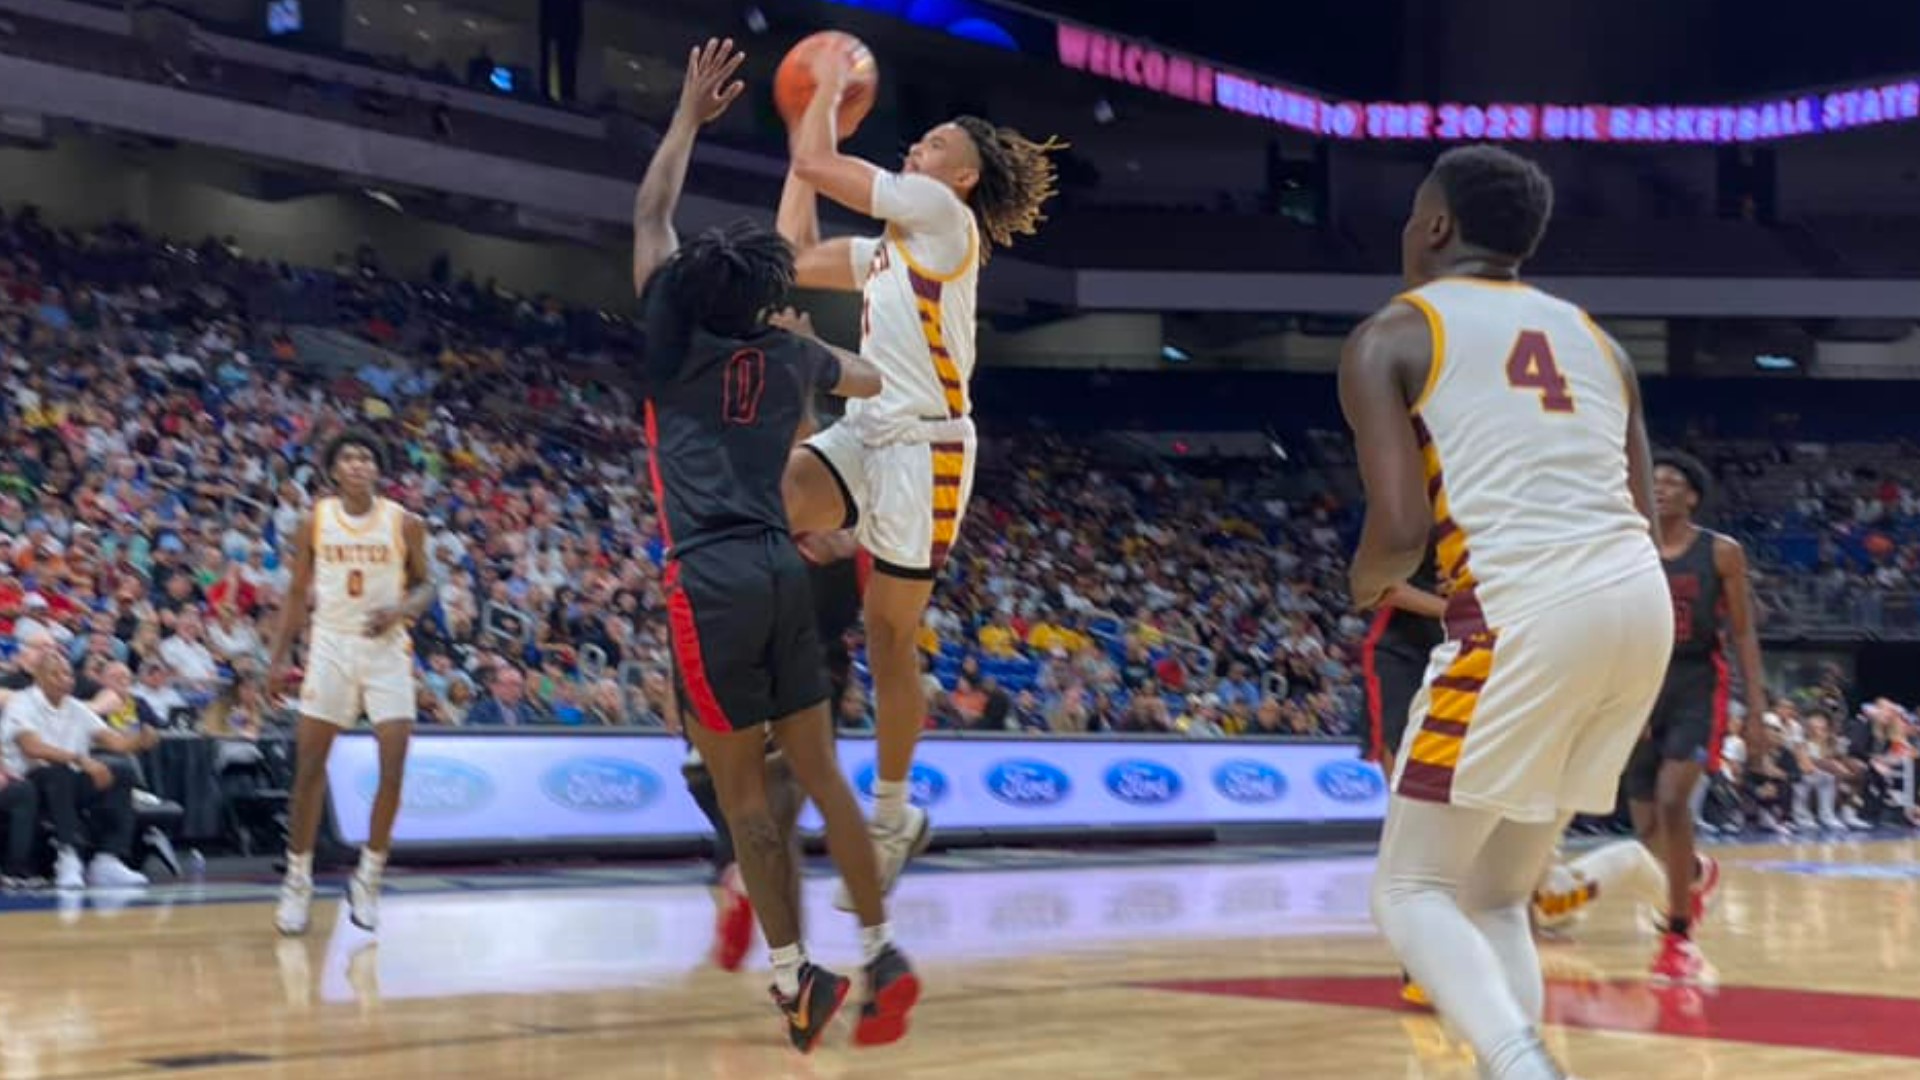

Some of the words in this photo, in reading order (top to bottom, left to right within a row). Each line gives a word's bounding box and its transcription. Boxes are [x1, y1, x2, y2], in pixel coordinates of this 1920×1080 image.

[1058, 23, 1214, 107] WELCOME
[1319, 102, 1357, 137] TO
[1365, 102, 1429, 138] THE
[1436, 102, 1533, 138] 2023
[1609, 98, 1813, 142] BASKETBALL
[1822, 83, 1918, 129] STATE
[722, 347, 765, 424] 0
[1505, 328, 1575, 413] 4
[323, 544, 391, 563] UNITED
[346, 568, 364, 599] 0
[1001, 764, 1058, 800] Ford
[1117, 763, 1169, 799] Ford
[1224, 765, 1276, 798] Ford
